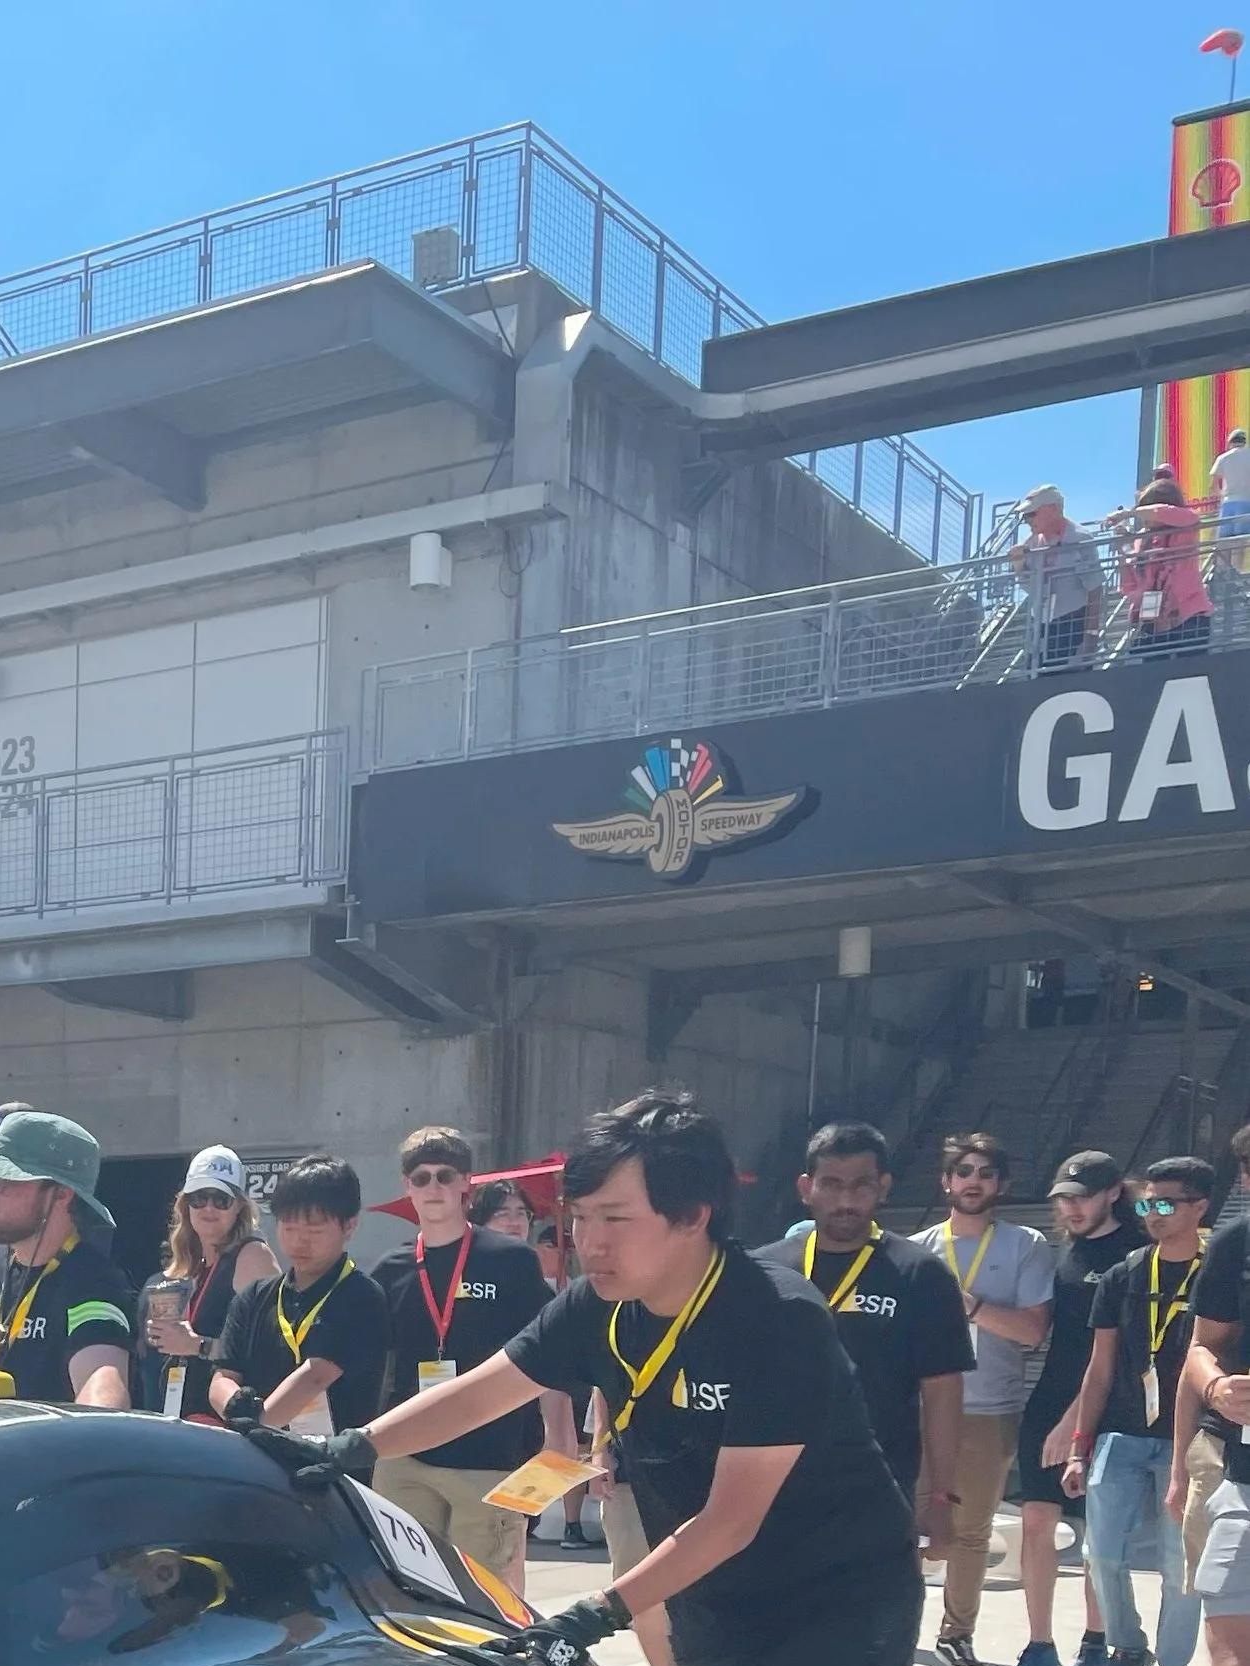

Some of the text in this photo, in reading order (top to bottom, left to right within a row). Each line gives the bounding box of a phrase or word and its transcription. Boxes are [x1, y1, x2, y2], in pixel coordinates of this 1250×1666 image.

[1018, 675, 1250, 831] GA
[672, 799, 690, 863] MOTOR
[700, 812, 763, 831] SPEEDWAY
[578, 824, 655, 846] INDIANAPOLIS
[271, 1162, 294, 1172] GAR
[248, 1173, 278, 1199] 24
[379, 1509, 427, 1557] 719
